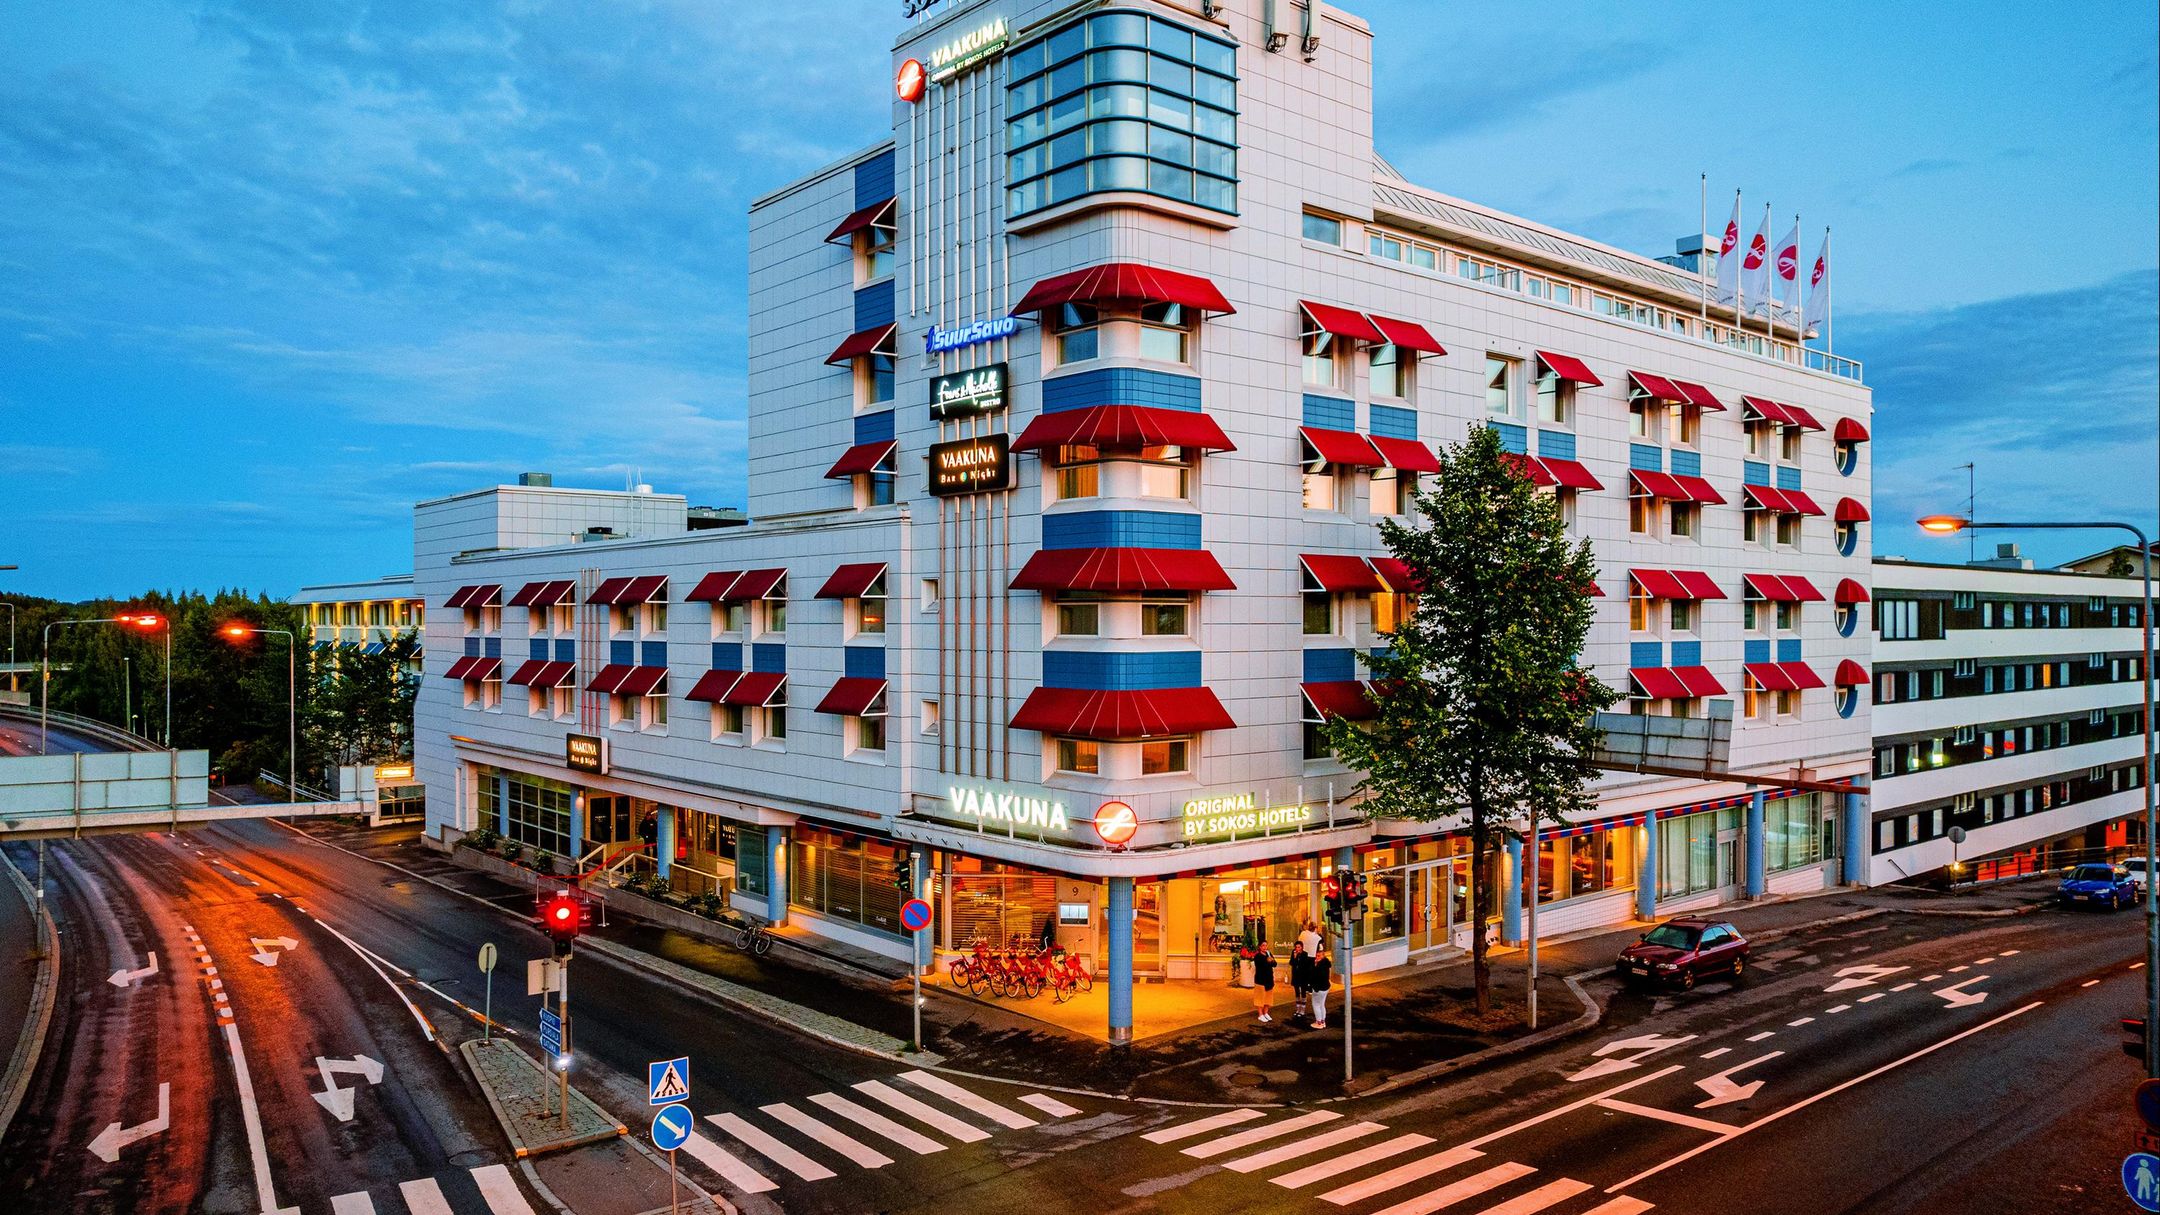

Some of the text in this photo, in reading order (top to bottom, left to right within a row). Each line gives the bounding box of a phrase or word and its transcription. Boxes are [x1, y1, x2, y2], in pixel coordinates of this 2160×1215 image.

[932, 18, 1006, 67] VAAKUNA
[956, 60, 965, 70] BY
[965, 53, 982, 67] SOKOS
[983, 42, 1005, 59] HOTELS
[941, 446, 996, 468] VAAKUNA
[950, 786, 1068, 831] VAAKUNA
[1185, 794, 1255, 817] ORIGINAL
[1185, 805, 1311, 837] BY SOKOS HOTELS
[1072, 886, 1079, 897] 9
